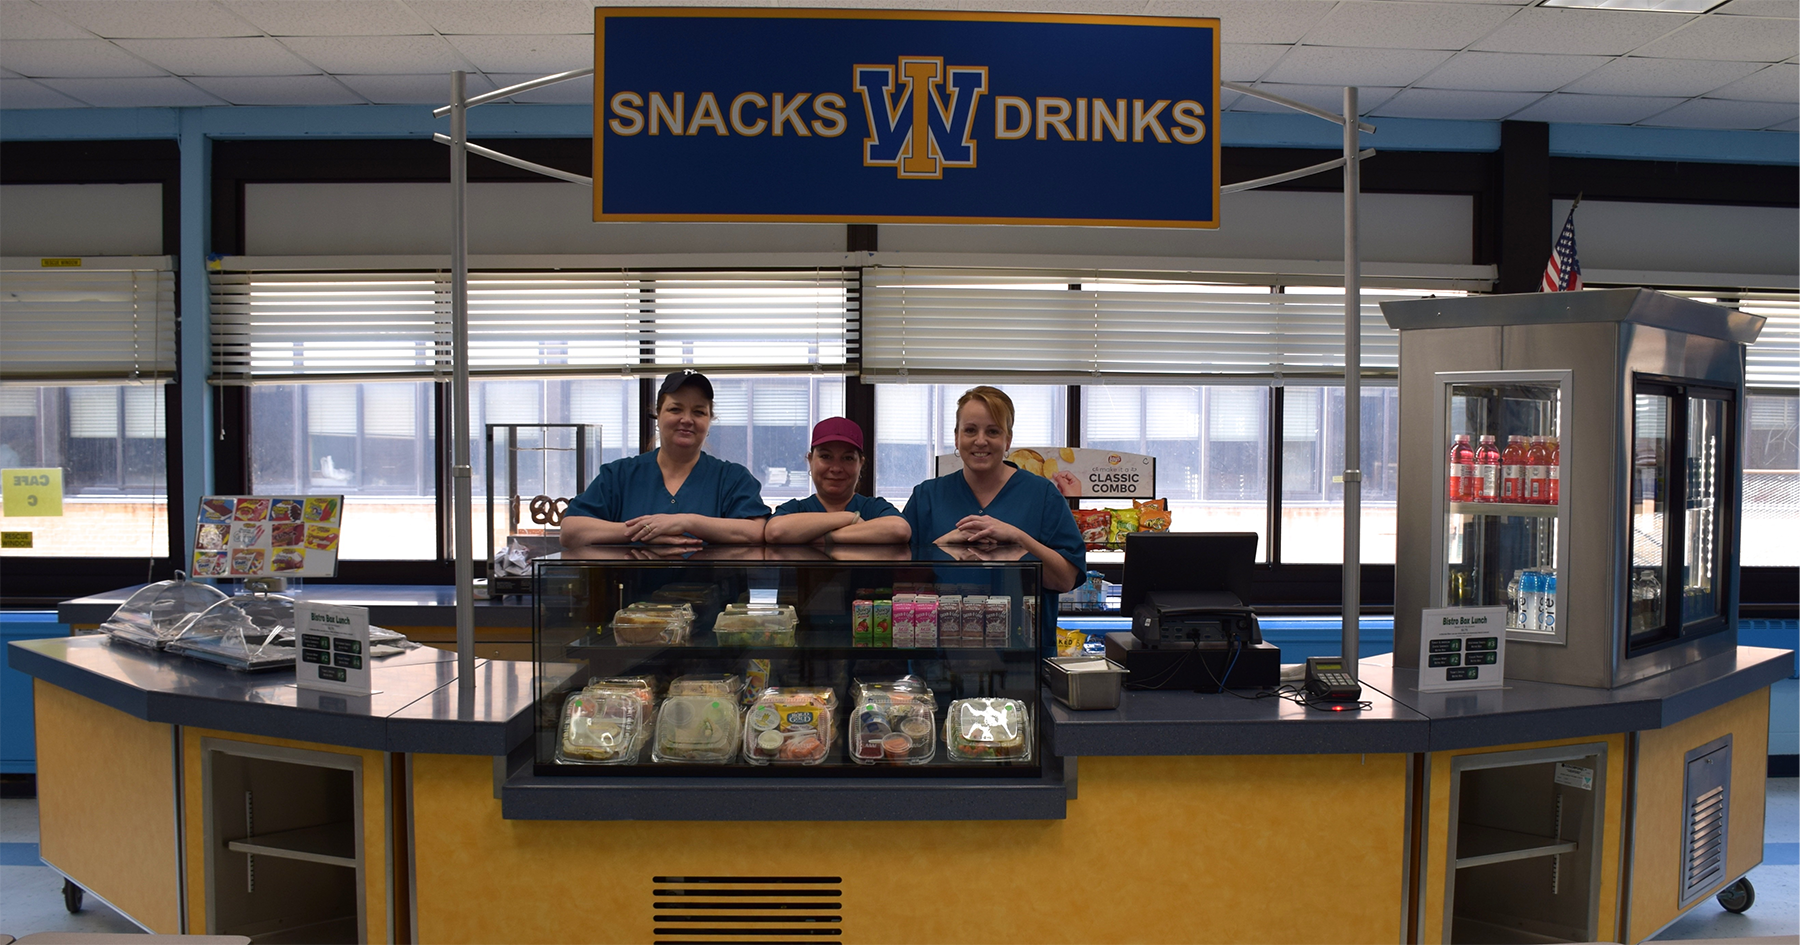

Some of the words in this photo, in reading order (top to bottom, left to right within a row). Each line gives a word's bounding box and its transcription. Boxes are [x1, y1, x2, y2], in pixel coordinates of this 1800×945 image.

[608, 90, 848, 138] SNACKS
[994, 95, 1207, 145] DRINKS
[1089, 473, 1139, 483] CLASSIC
[1092, 483, 1137, 493] COMBO
[311, 612, 325, 622] Bistro
[326, 614, 335, 623] Box
[336, 615, 350, 625] Lunch
[1443, 617, 1459, 625] Bistro
[1460, 616, 1470, 625] Box
[1471, 616, 1487, 624] Lunch
